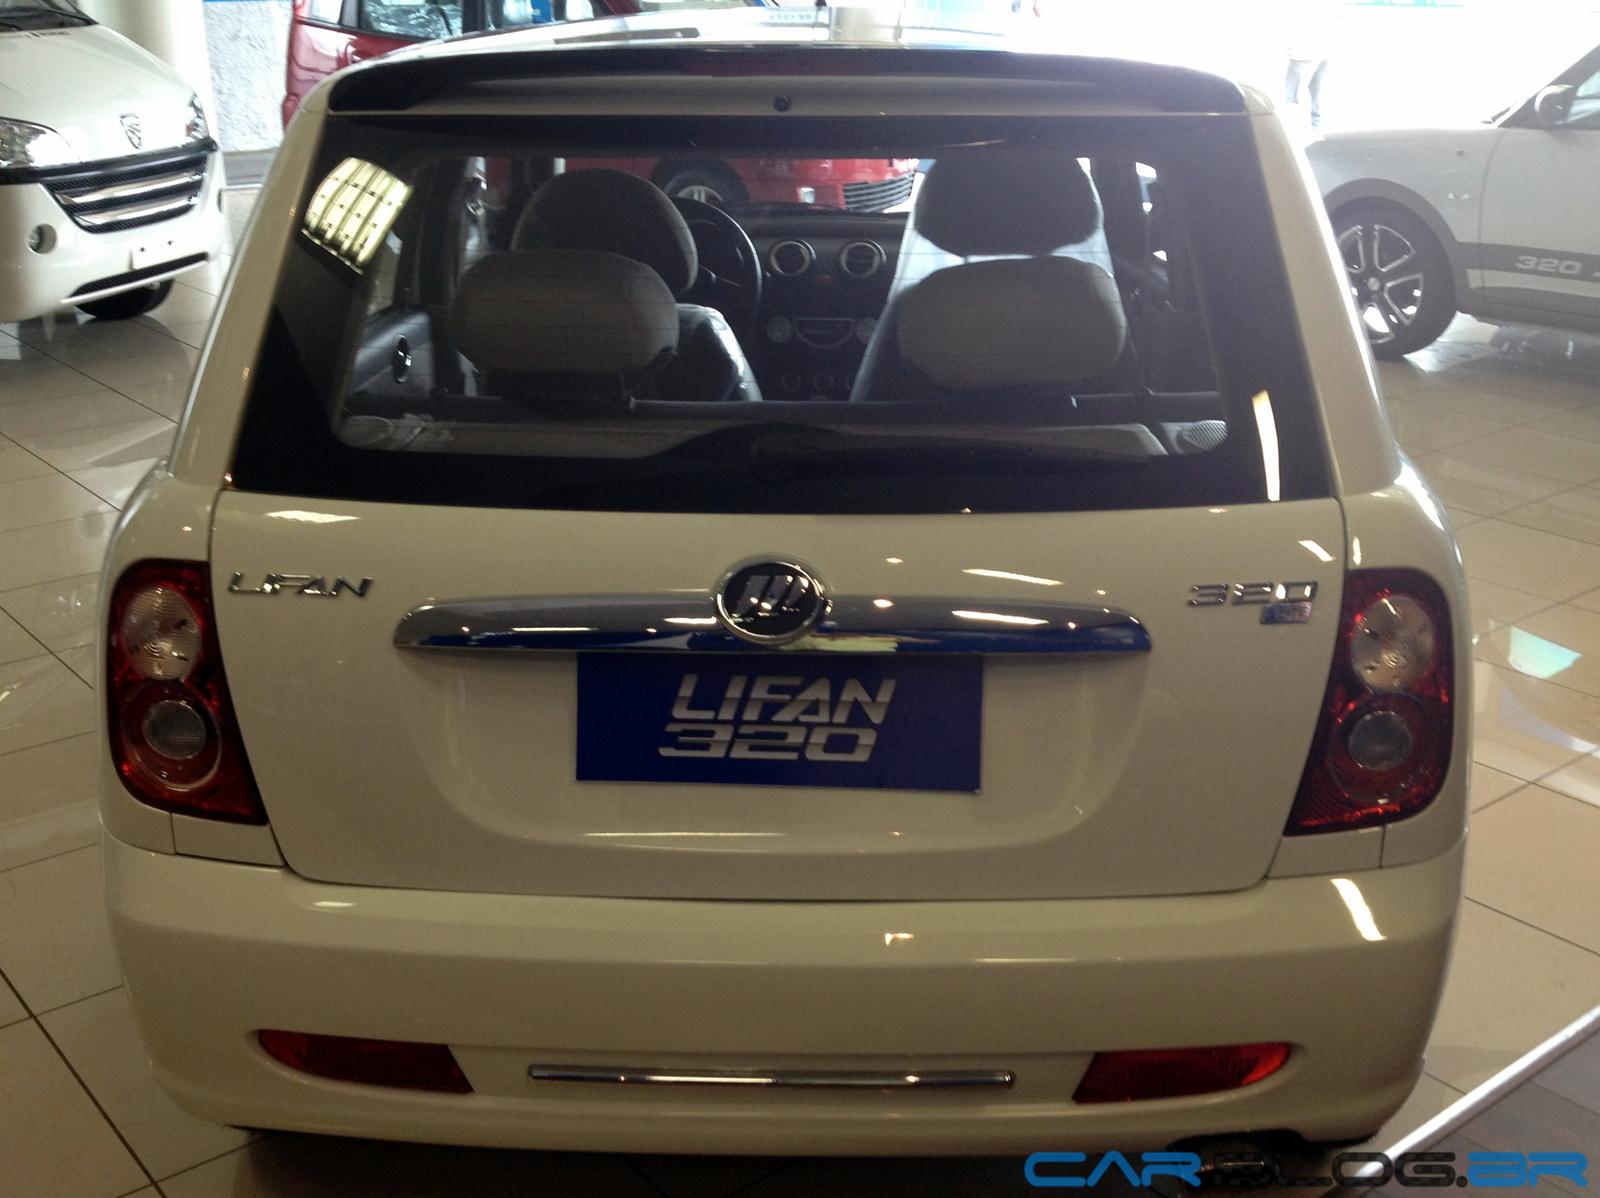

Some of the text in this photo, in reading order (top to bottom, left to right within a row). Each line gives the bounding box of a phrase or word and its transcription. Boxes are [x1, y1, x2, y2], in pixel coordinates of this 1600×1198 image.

[1515, 255, 1582, 275] 320
[1188, 580, 1318, 607] 320
[671, 673, 896, 725] LIFAN
[658, 722, 878, 763] 320
